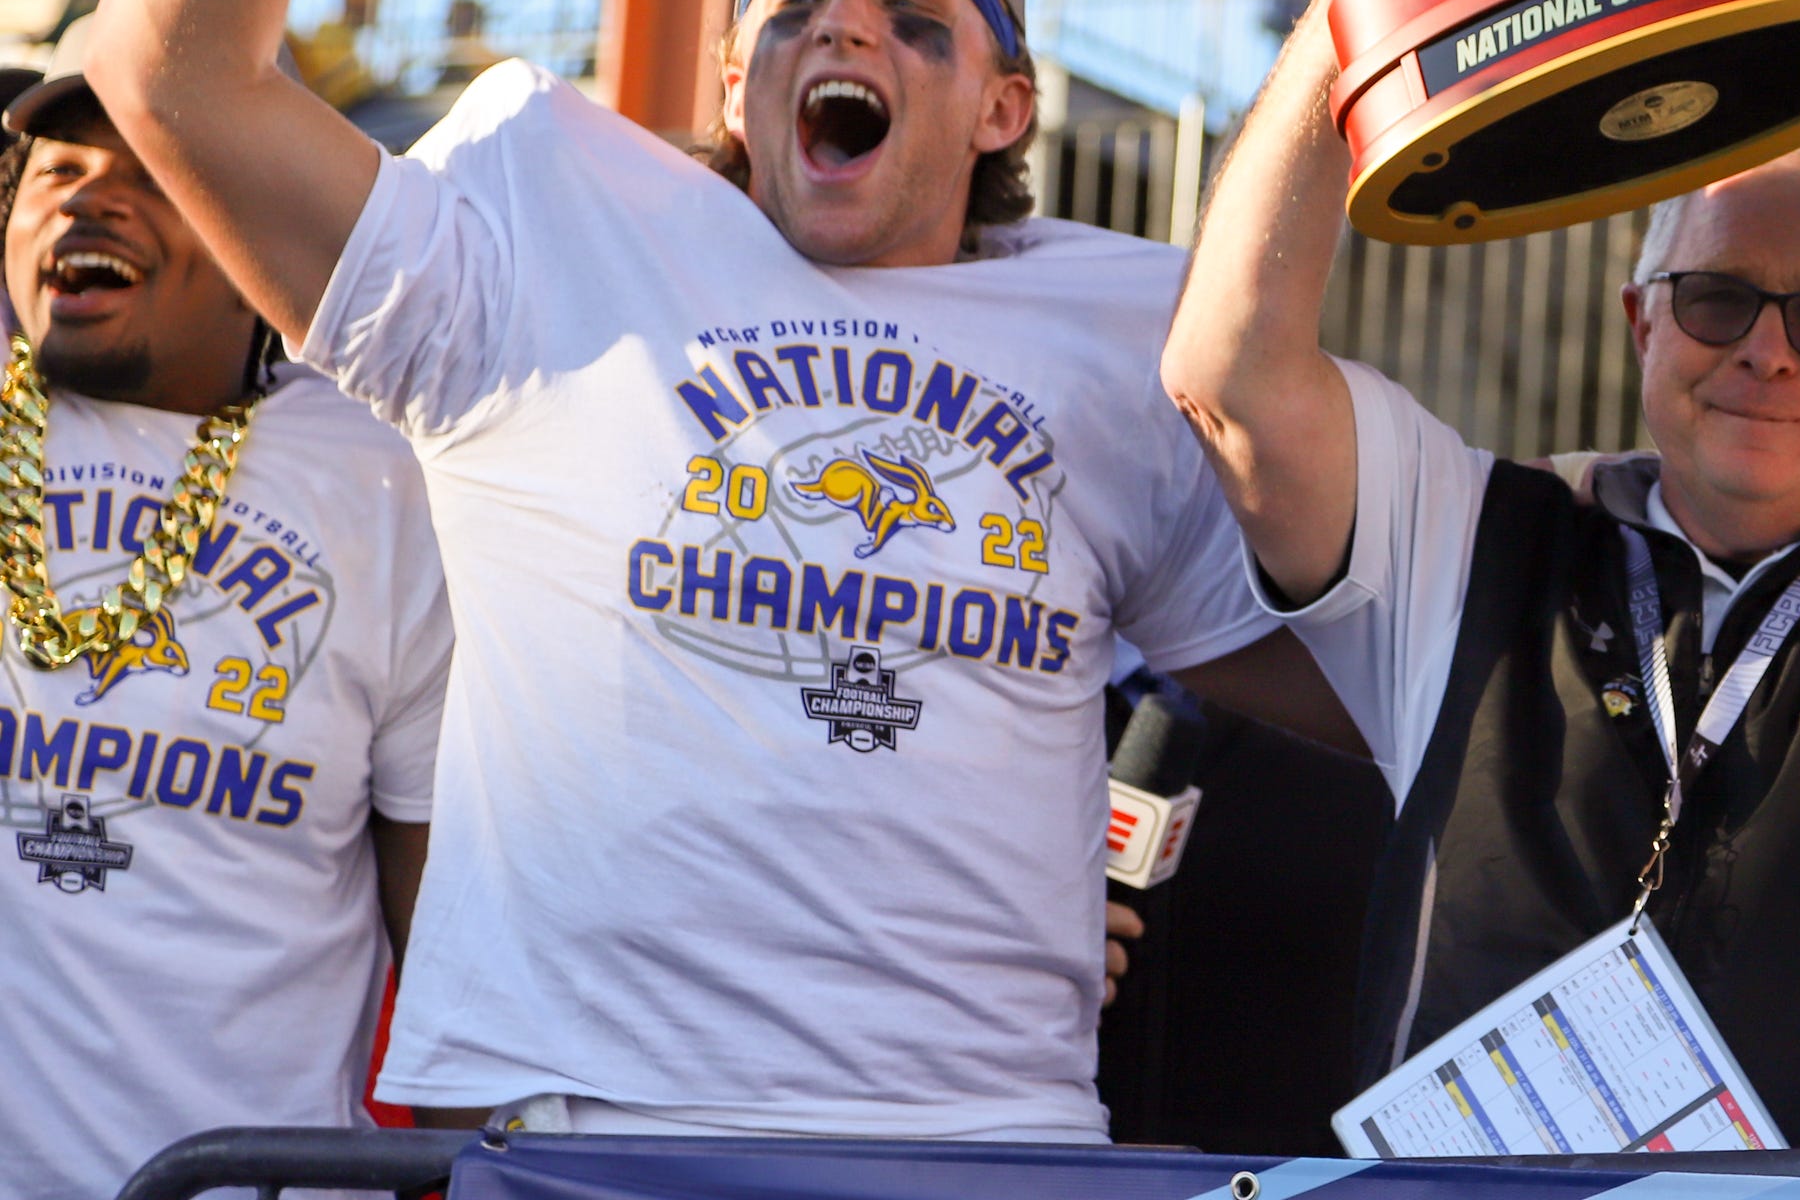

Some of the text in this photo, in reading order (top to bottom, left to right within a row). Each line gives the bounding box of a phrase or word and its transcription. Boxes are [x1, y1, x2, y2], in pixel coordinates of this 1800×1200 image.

[697, 325, 758, 349] NCAA
[770, 319, 899, 341] DIVISION
[675, 343, 1054, 504] NATIONAL
[205, 490, 321, 568] OOTBALL
[682, 455, 1050, 575] 20 22
[43, 487, 322, 650] TIONAL
[627, 537, 1081, 675] CHAMPIONS
[206, 656, 290, 723] 22
[811, 696, 915, 722] CHAMPIONSHIP
[837, 686, 889, 704] FOOTBALL
